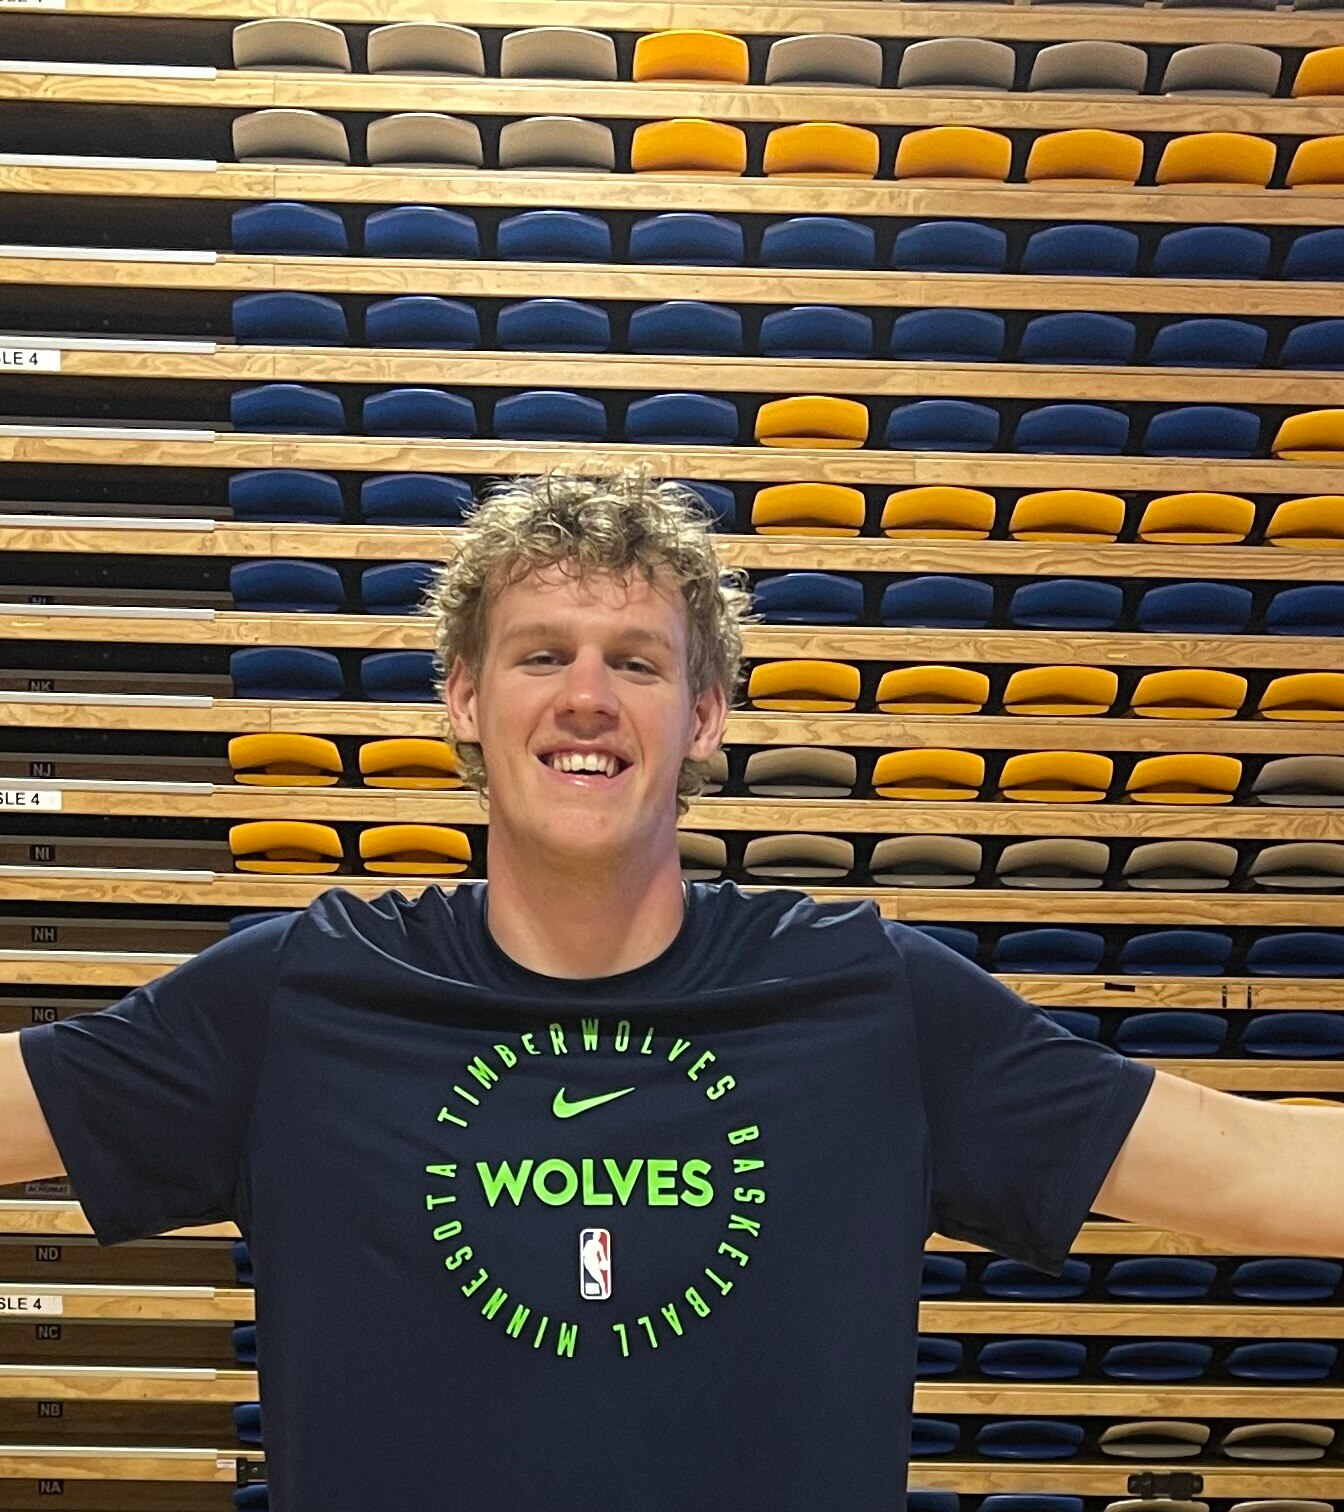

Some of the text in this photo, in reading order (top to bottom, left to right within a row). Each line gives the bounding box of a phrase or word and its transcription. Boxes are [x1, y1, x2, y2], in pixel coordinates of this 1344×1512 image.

[28, 352, 38, 366] 4
[33, 763, 51, 776] NJ
[30, 792, 40, 806] 4
[35, 847, 50, 860] NI
[34, 928, 55, 942] NH
[34, 1008, 55, 1023] NG
[425, 1018, 765, 1358] MINNESOTA TIMBERWOLVES BASKETBALL
[475, 1158, 715, 1208] WOLVES
[38, 1247, 59, 1261] ND
[32, 1297, 42, 1311] 4
[38, 1325, 59, 1339] NC
[40, 1403, 60, 1417] NB
[40, 1480, 61, 1494] NA
